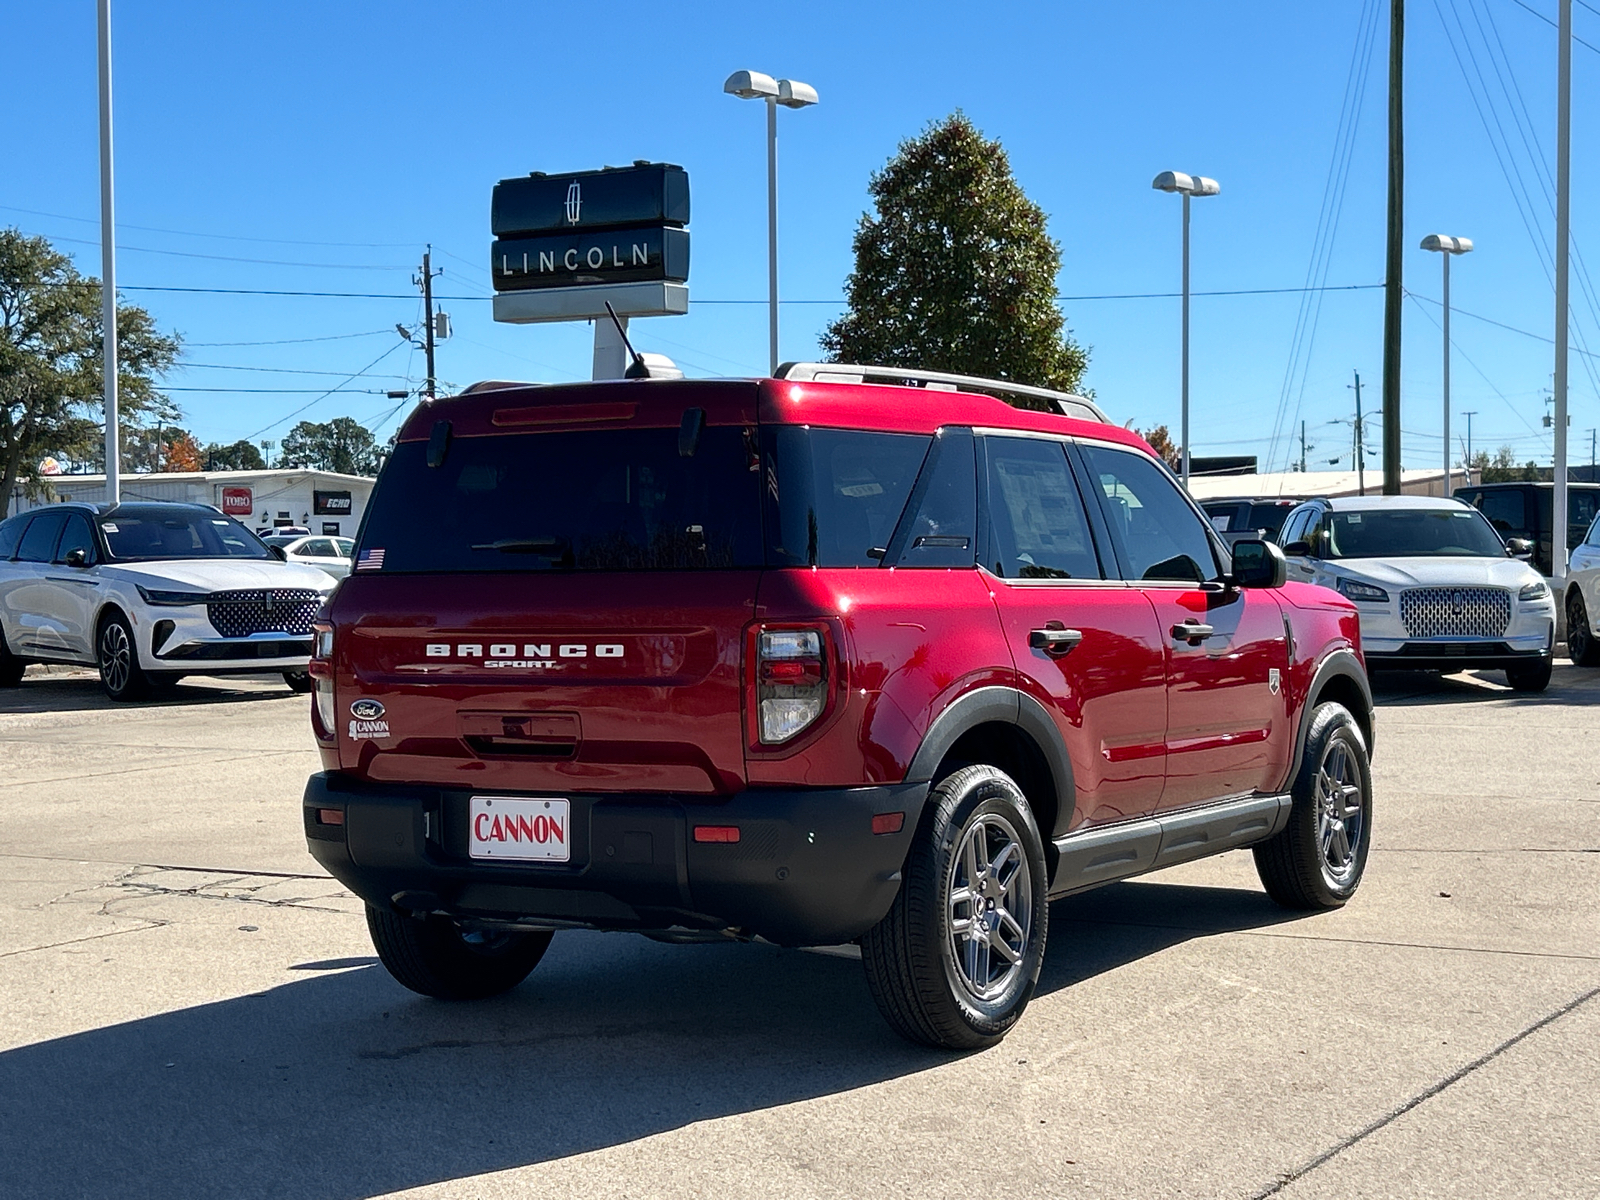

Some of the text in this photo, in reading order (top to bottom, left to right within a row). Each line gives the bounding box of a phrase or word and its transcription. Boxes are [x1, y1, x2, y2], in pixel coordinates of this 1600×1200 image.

[502, 242, 648, 276] LINCOLN
[326, 498, 350, 508] ECHO
[426, 644, 625, 658] BRONCO
[484, 660, 557, 668] SPORT
[356, 703, 377, 716] Ford
[357, 720, 390, 732] CANNON
[474, 813, 565, 845] CANNON
